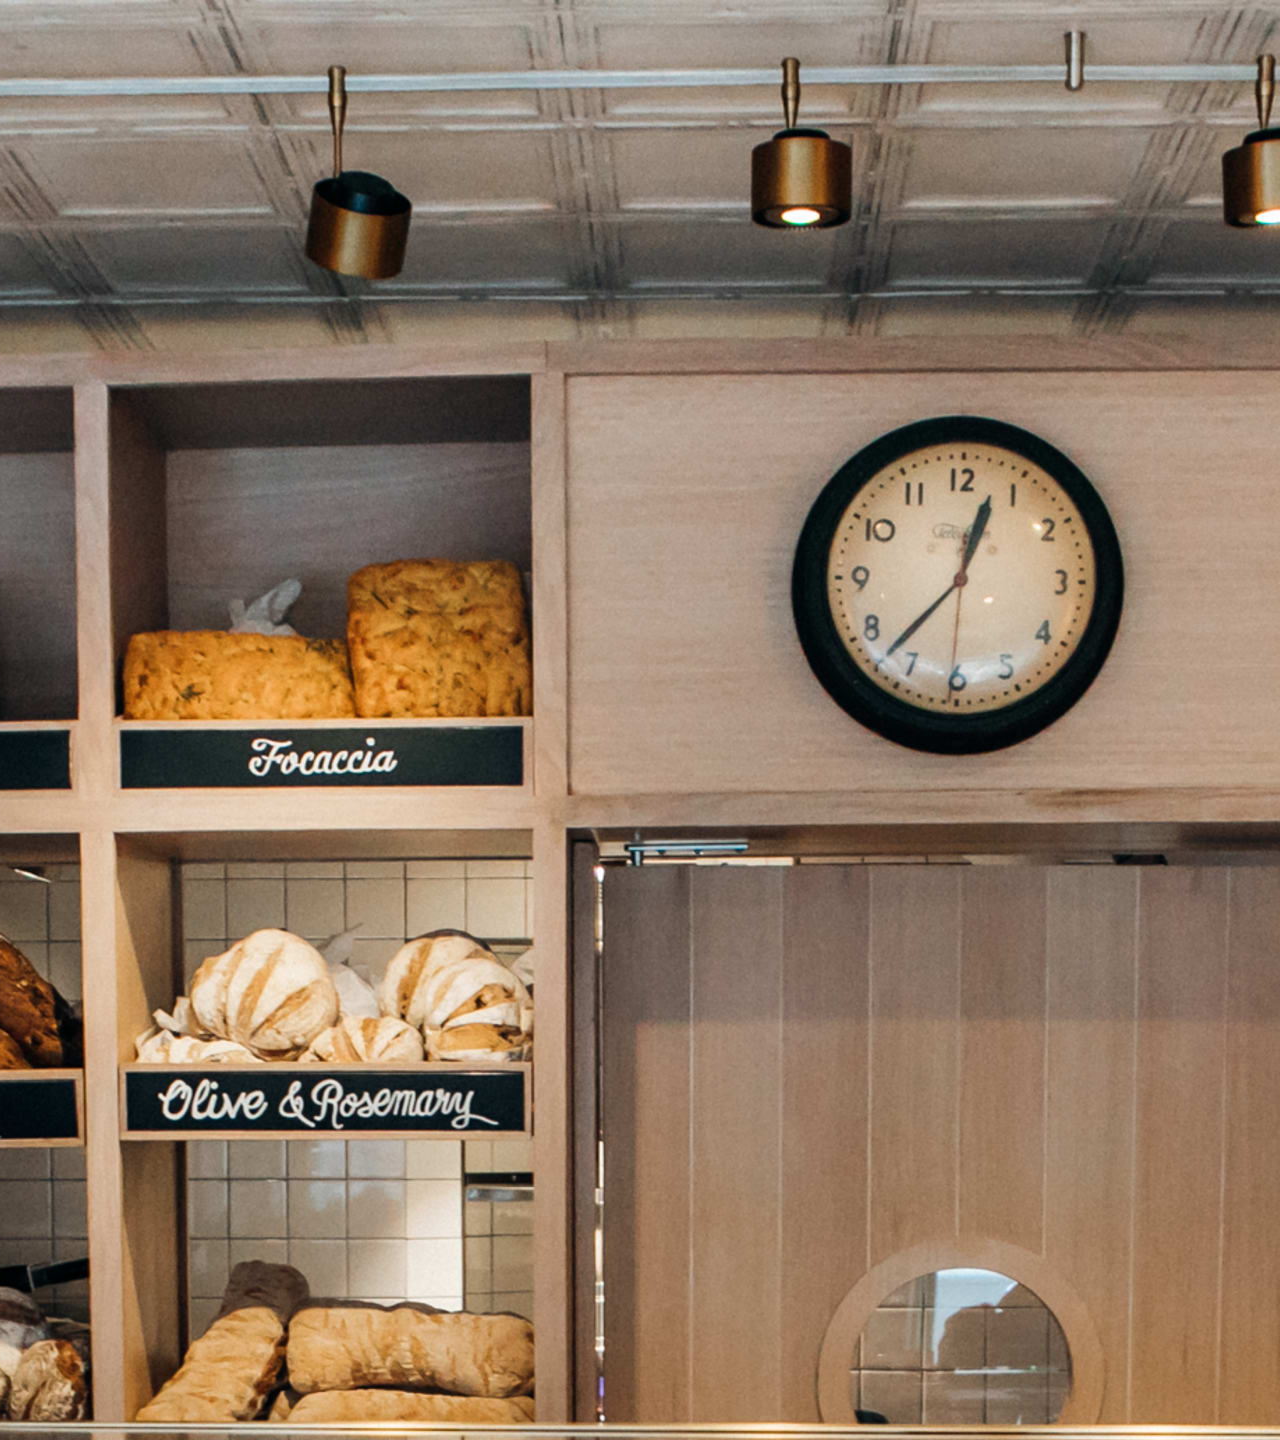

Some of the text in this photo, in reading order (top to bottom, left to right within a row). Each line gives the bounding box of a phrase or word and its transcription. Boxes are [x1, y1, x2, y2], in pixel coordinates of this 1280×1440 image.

[950, 467, 975, 492] 12
[905, 481, 924, 506] 11
[1010, 483, 1016, 507] 1
[865, 518, 896, 542] 10
[1040, 518, 1055, 542] 2
[851, 565, 870, 591] 9
[1054, 569, 1068, 595] 3
[863, 614, 880, 641] 8
[1034, 620, 1052, 645] 4
[899, 652, 919, 676] 7
[998, 654, 1014, 680] 5
[948, 665, 967, 691] 6
[248, 736, 398, 777] Focaccia
[157, 1078, 500, 1130] Olive & Rosemary
